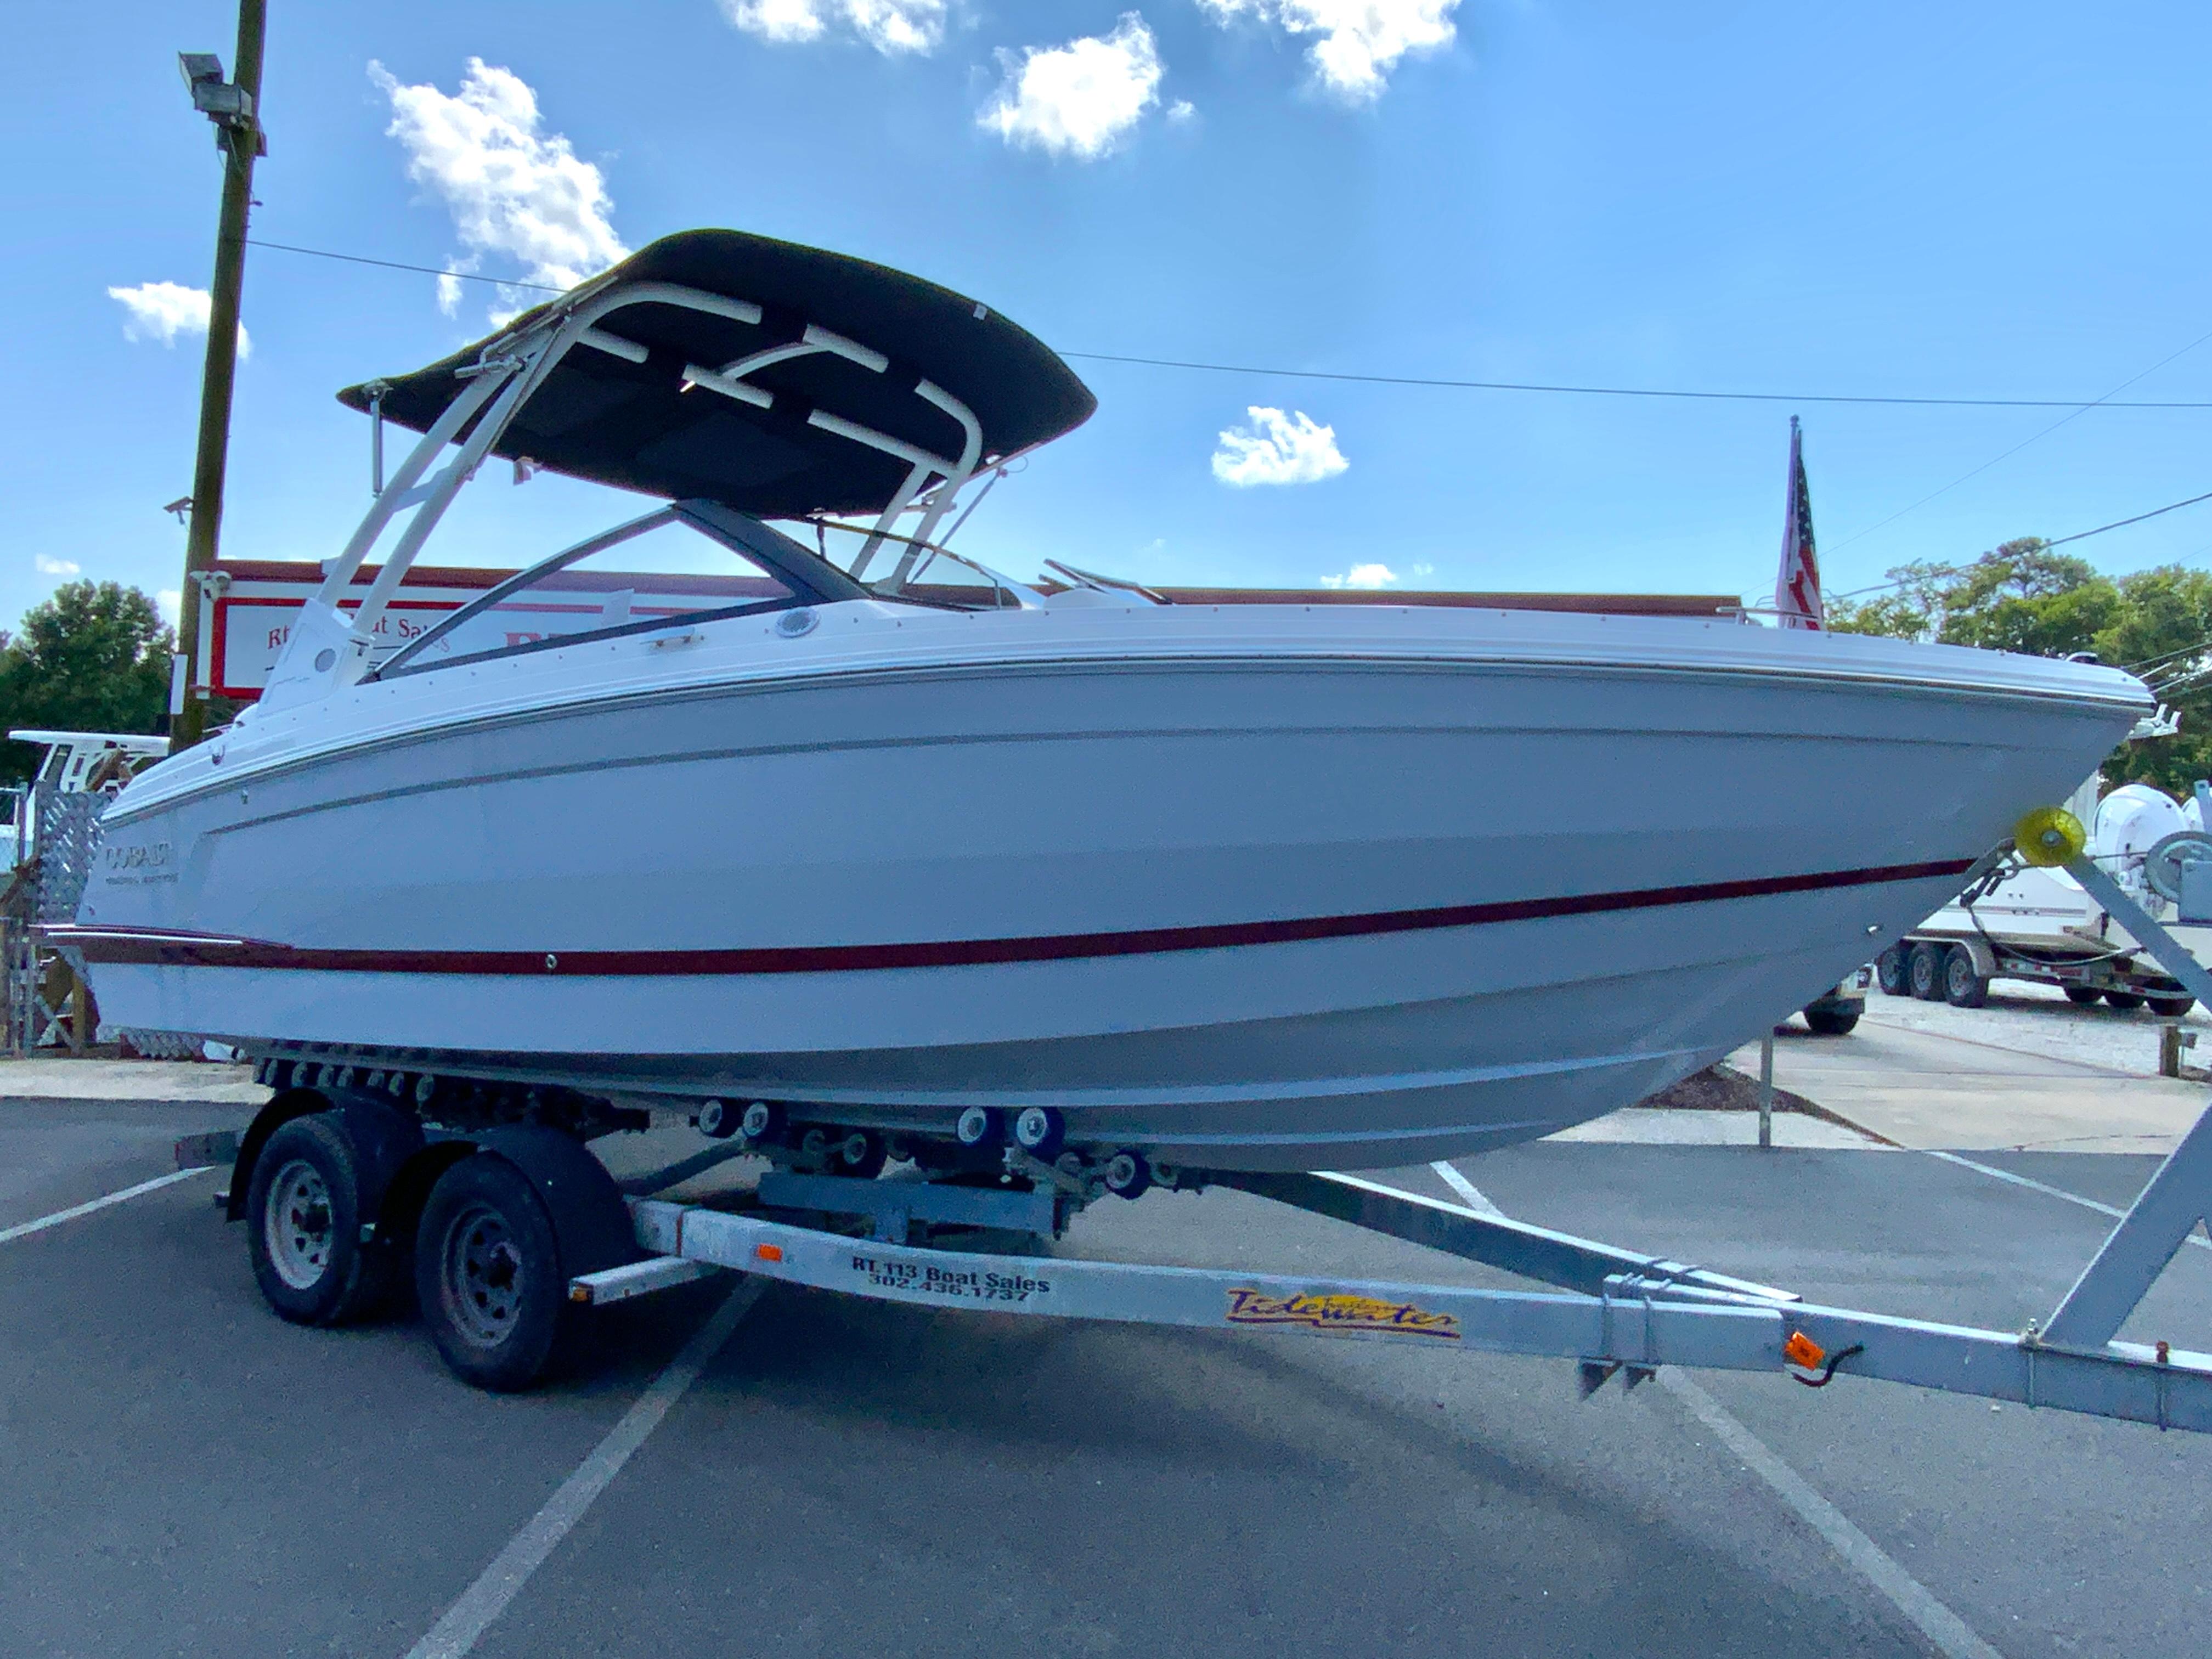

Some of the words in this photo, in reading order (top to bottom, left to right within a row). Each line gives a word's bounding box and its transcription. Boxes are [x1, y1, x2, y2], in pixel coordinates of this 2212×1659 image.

[868, 1273, 1031, 1301] 302.436.1737
[926, 1266, 978, 1286] Boat
[985, 1272, 1051, 1293] Sales
